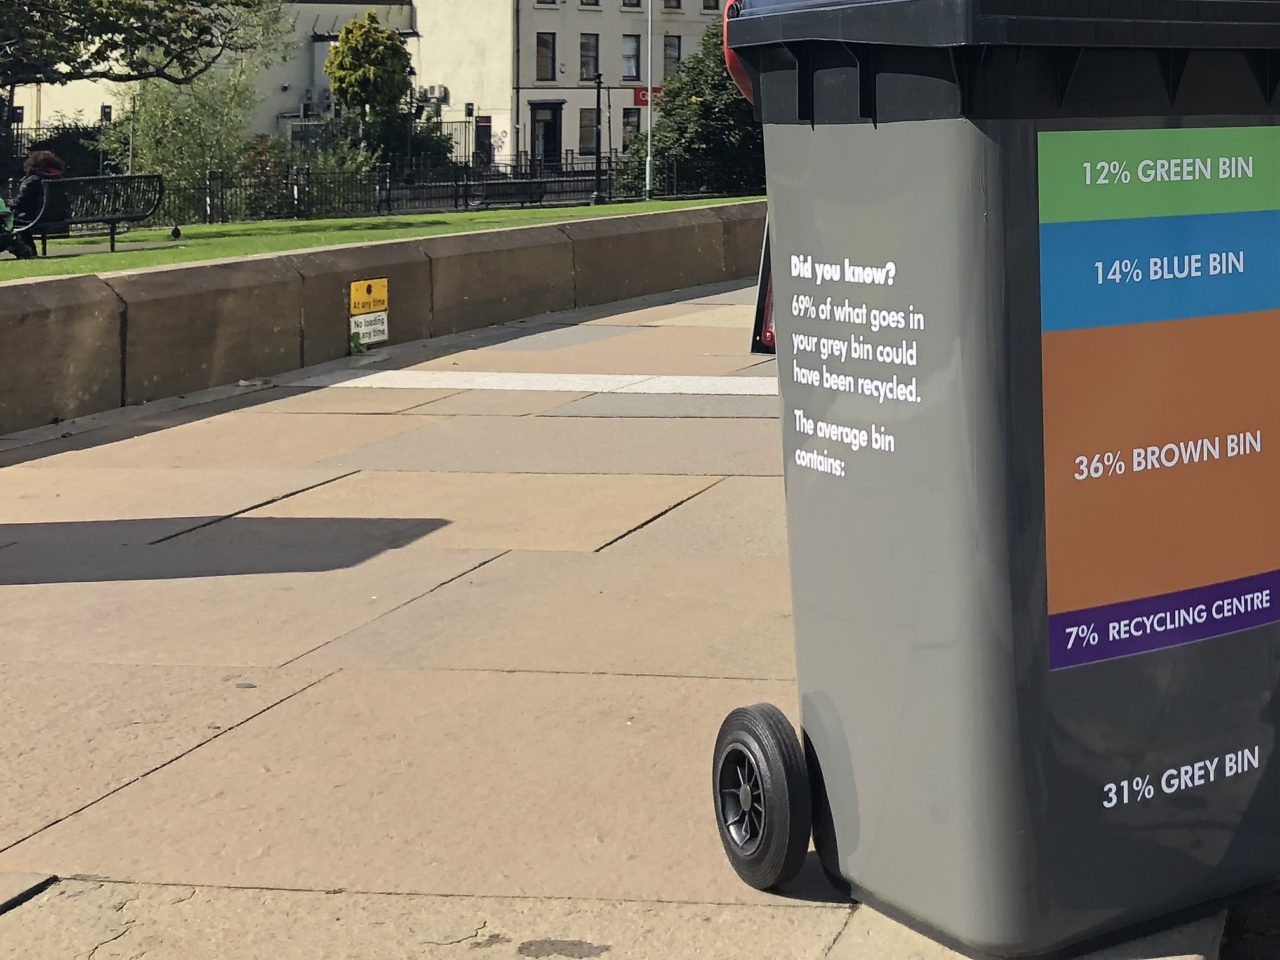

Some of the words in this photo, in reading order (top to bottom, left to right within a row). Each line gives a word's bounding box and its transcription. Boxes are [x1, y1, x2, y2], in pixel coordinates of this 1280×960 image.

[1082, 160, 1131, 185] 12%
[1137, 157, 1212, 183] GREEN
[1218, 156, 1254, 180] BIN
[790, 254, 813, 279] Did
[815, 262, 841, 286] you
[844, 257, 896, 286] know?
[1094, 258, 1143, 285] 14%
[1149, 254, 1202, 281] BLUE
[1208, 250, 1244, 276] BIN
[353, 301, 360, 309] At
[361, 301, 371, 310] any
[791, 294, 817, 319] 69%
[818, 296, 832, 321] of
[833, 299, 867, 325] what
[870, 307, 906, 332] goes
[909, 304, 925, 331] in
[354, 319, 363, 329] No
[791, 332, 818, 355] your
[820, 336, 849, 363] grey
[851, 333, 873, 361] bin
[876, 339, 918, 366] could
[793, 359, 820, 387] have
[822, 364, 855, 393] been
[858, 374, 922, 404] recycled.
[793, 408, 815, 436] The
[816, 419, 868, 452] average
[871, 424, 895, 453] bin
[794, 447, 846, 478] contains:
[1073, 450, 1126, 481] 36%
[1132, 436, 1220, 473] BROWN
[1227, 430, 1262, 458] BIN
[1065, 623, 1099, 650] 7%
[1108, 604, 1207, 642] RECYCLING
[1211, 589, 1271, 619] CENTRE
[1102, 774, 1155, 809] 31%
[1160, 757, 1219, 795] GREY
[1225, 745, 1259, 778] BIN
